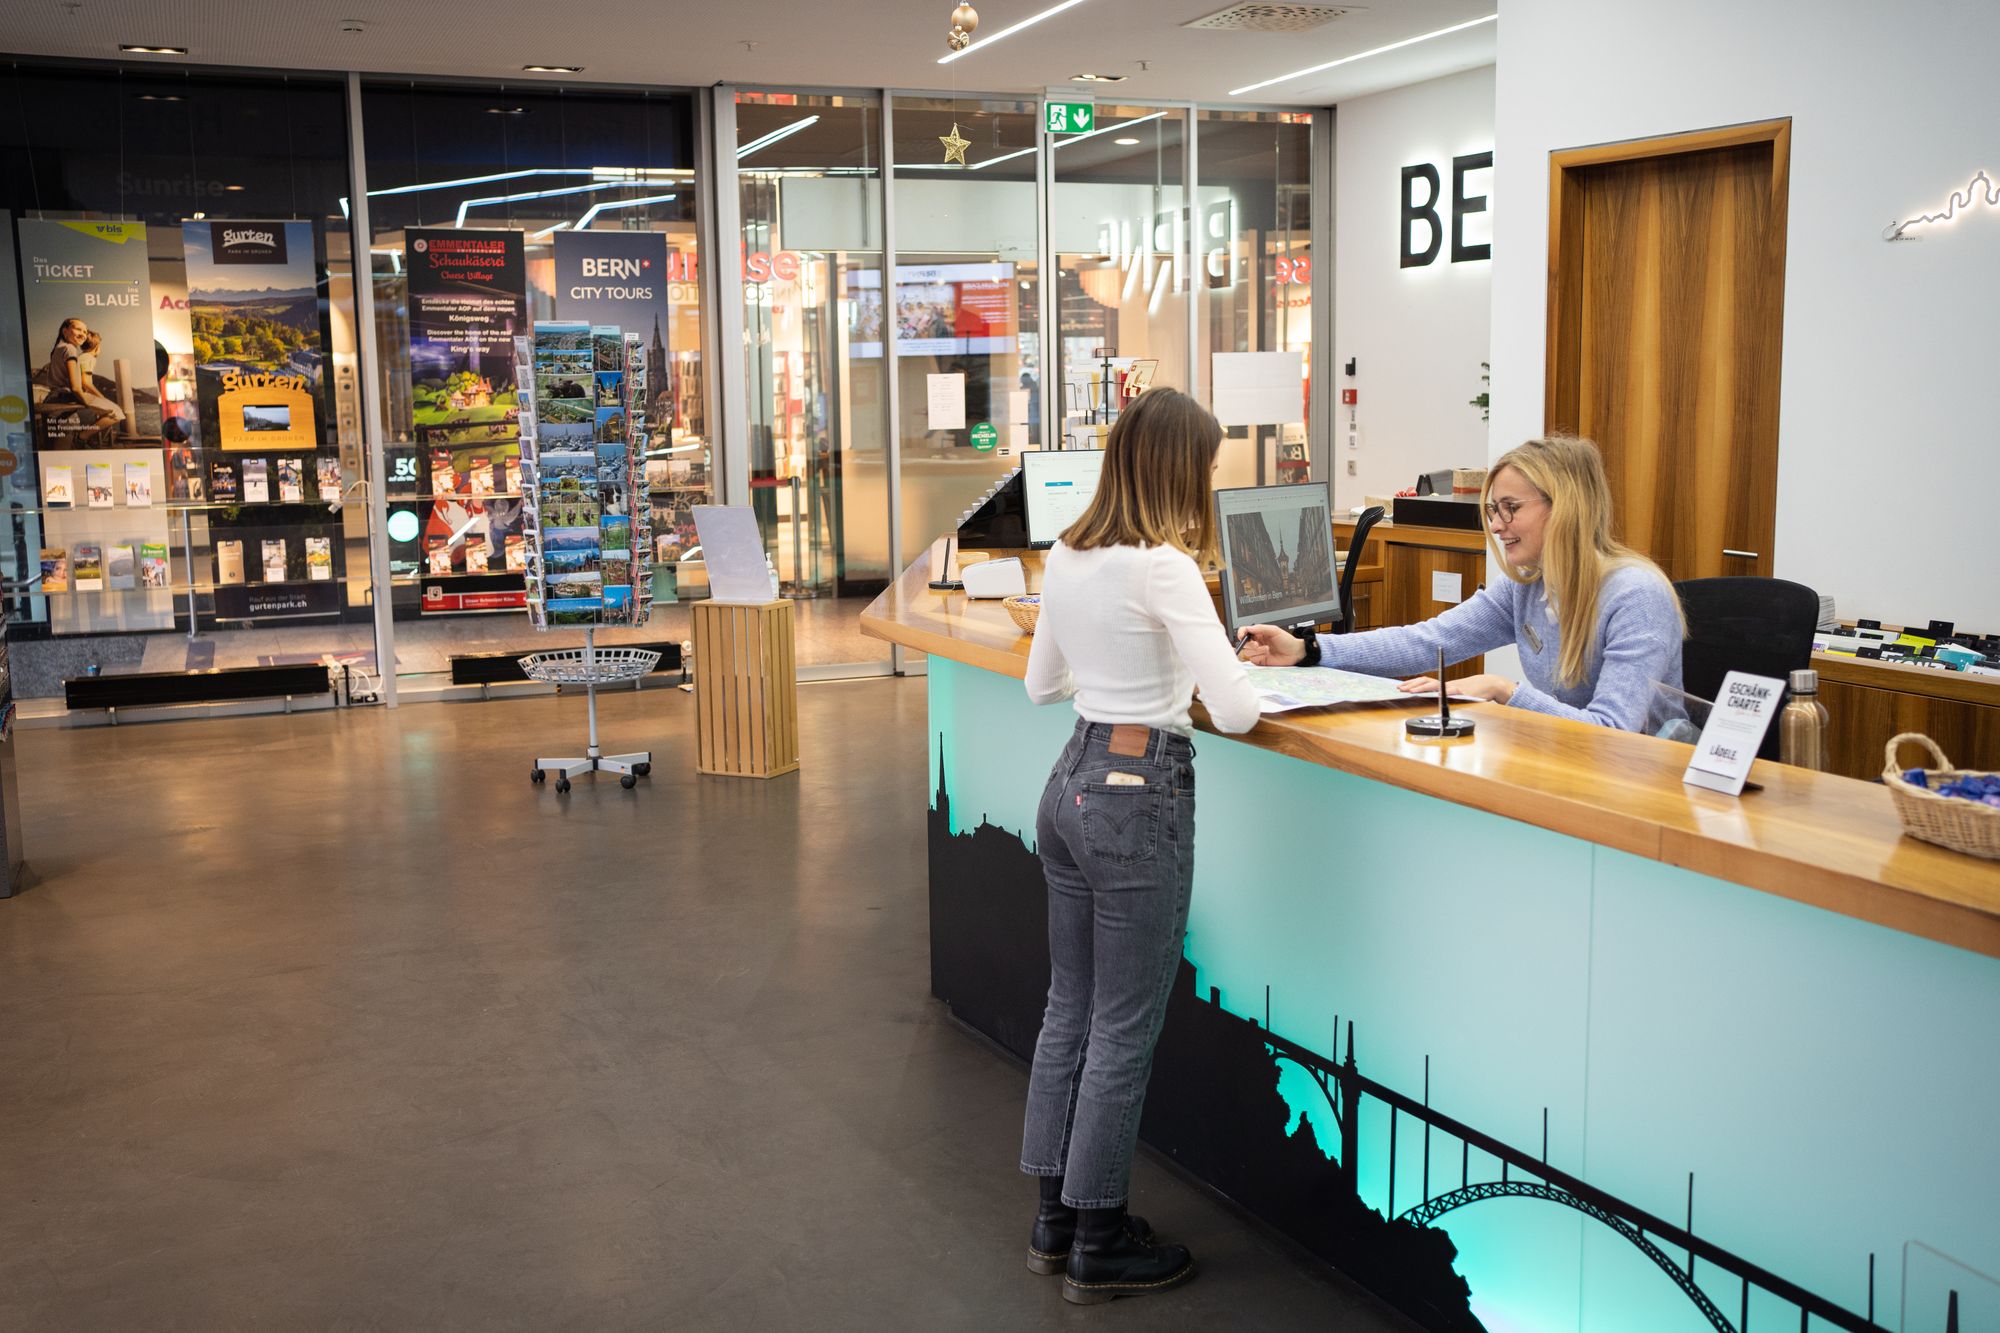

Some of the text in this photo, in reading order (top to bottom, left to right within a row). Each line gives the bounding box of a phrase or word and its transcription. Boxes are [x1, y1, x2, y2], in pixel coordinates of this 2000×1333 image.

[116, 172, 224, 197] Sunrise
[1400, 151, 1493, 269] BE
[106, 225, 123, 233] bls
[223, 228, 274, 243] gurten
[429, 240, 505, 249] EMMENTALER
[429, 253, 505, 269] Schaukäserei
[34, 264, 94, 278] TICKET
[467, 271, 494, 281] Village
[582, 258, 640, 281] BERN
[84, 293, 140, 307] BLAUE
[570, 286, 653, 300] CITY TOURS
[449, 315, 490, 323] Königsweg
[475, 346, 490, 354] way
[222, 371, 305, 392] gurten
[249, 600, 307, 612] gurtenpark.ch
